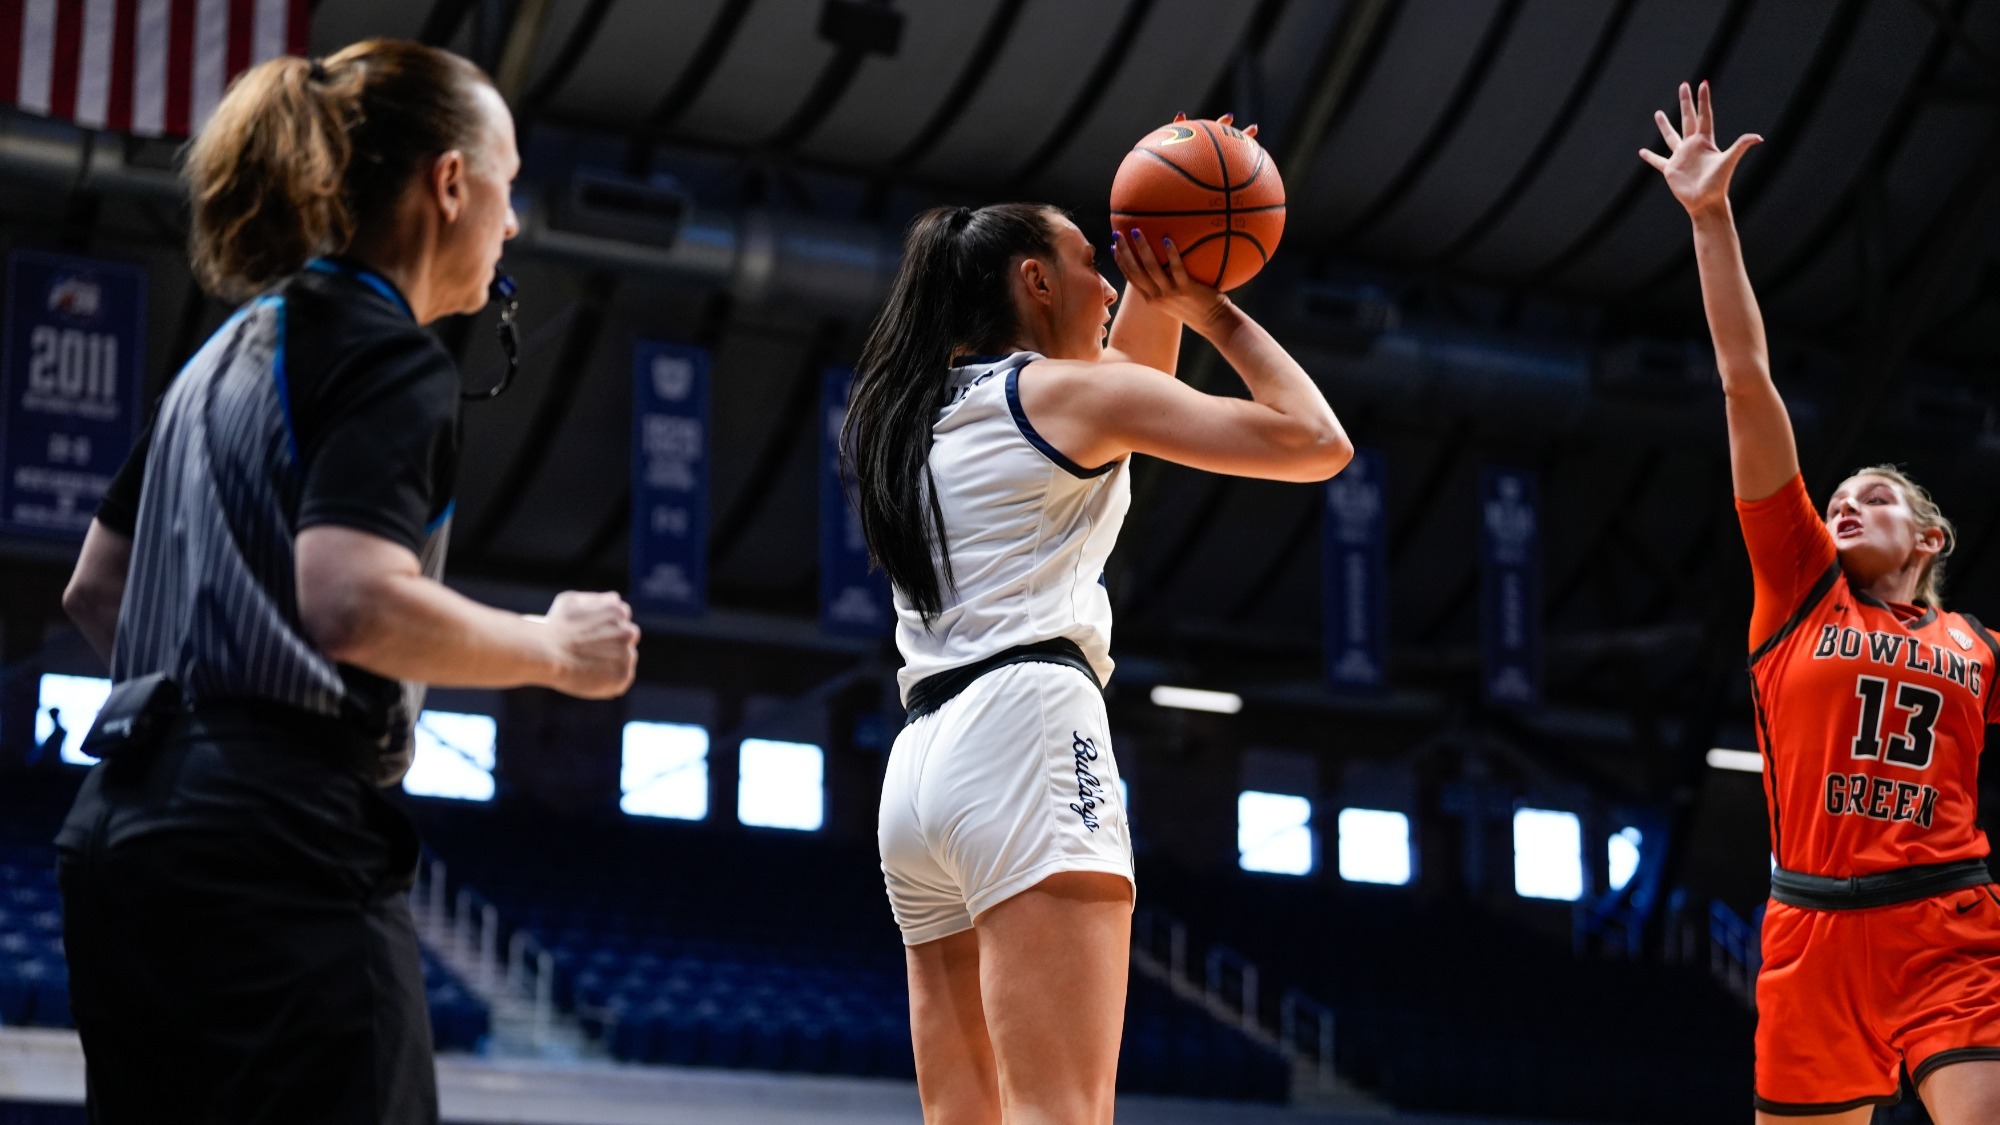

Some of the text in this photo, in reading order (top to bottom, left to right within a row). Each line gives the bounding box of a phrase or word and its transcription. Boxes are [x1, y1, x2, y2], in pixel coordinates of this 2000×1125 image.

[29, 325, 118, 399] 2011
[1813, 624, 1983, 698] BOWLING
[1850, 673, 1944, 771] 13
[1069, 730, 1104, 833] Bulldogs
[1825, 772, 1939, 830] GREEN
